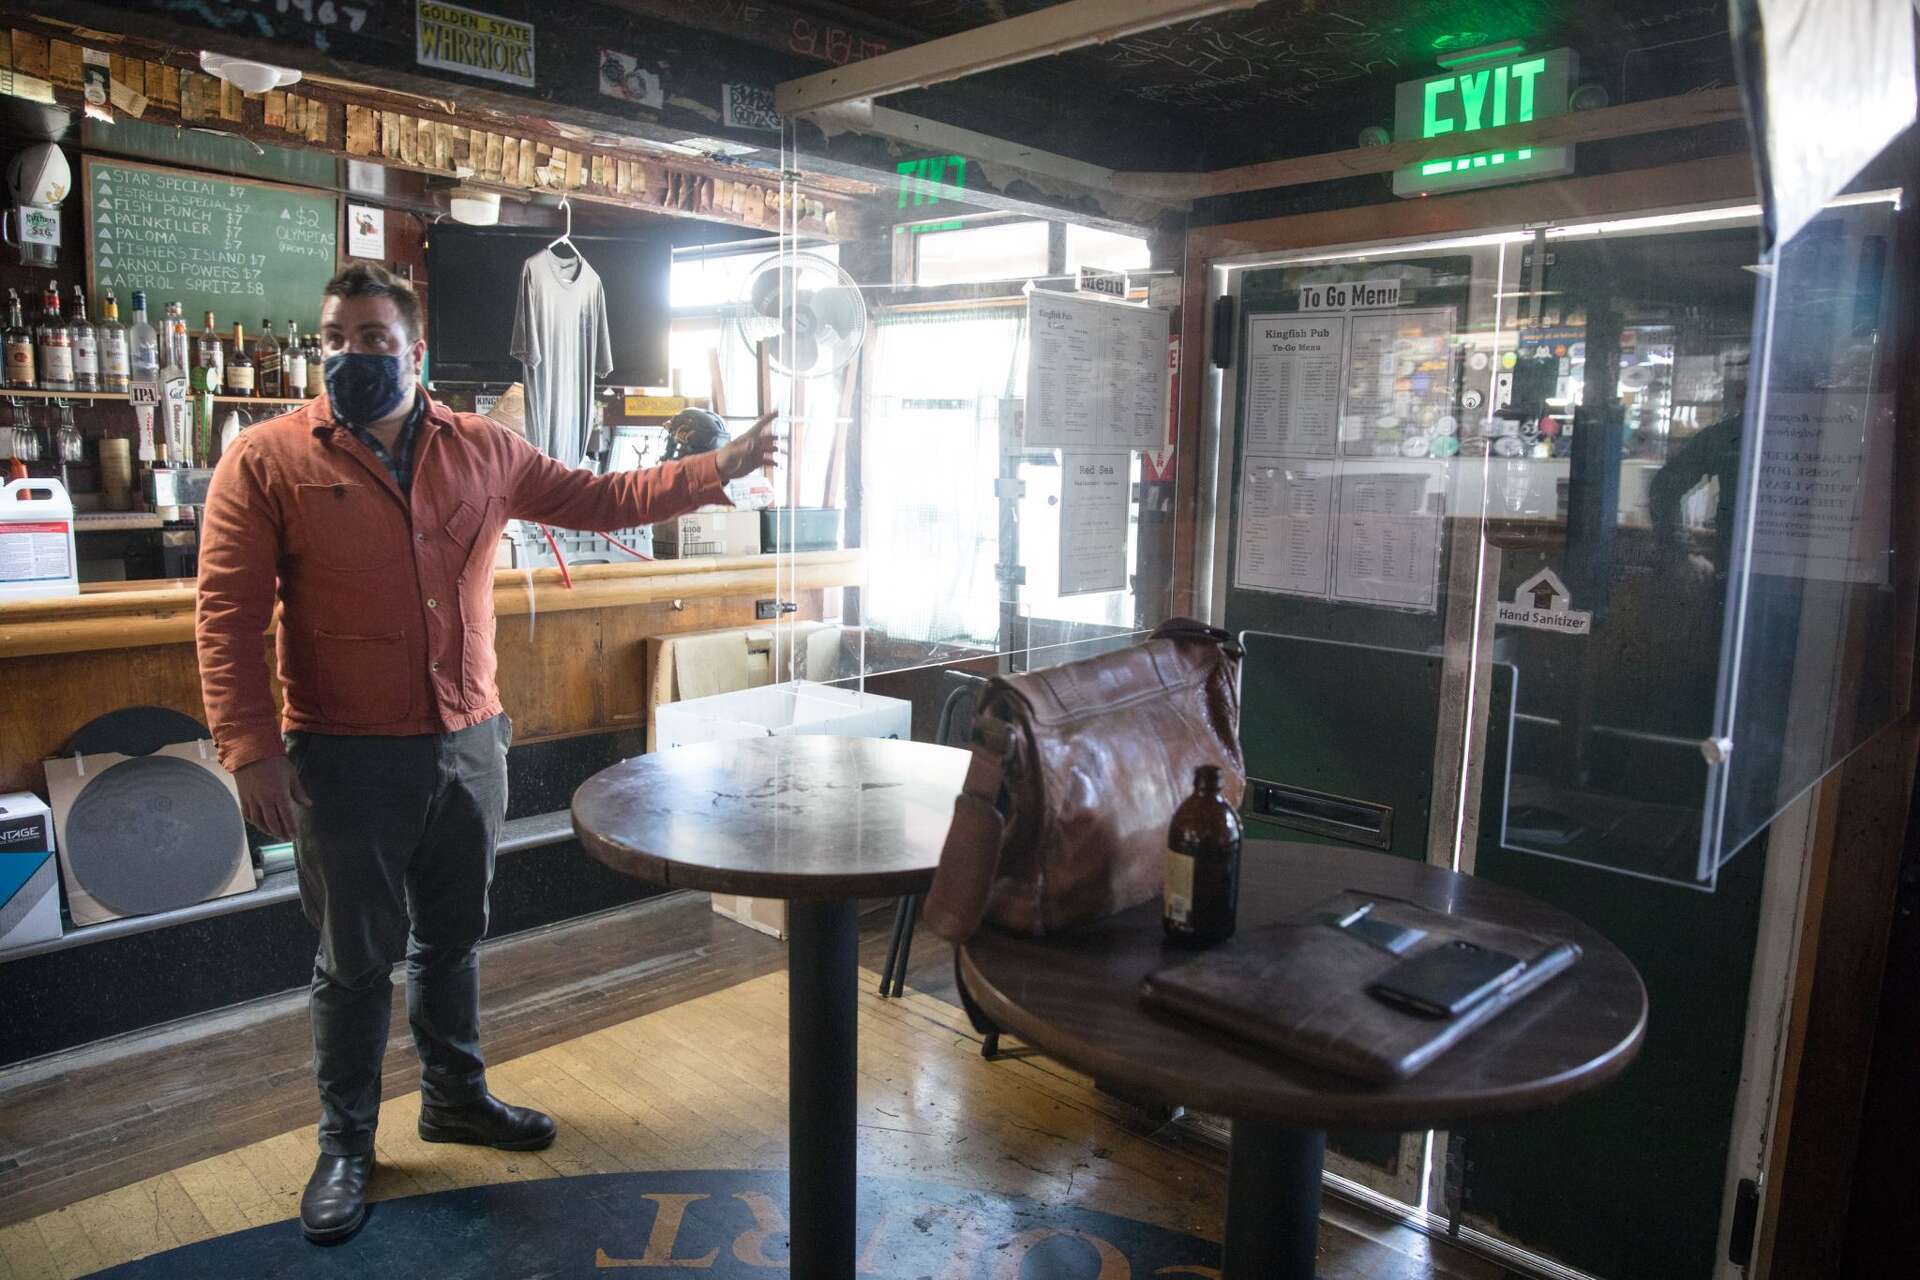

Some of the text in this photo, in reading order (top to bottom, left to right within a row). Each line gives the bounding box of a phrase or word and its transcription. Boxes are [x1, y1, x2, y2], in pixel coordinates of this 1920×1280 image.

[421, 4, 530, 39] GOLDEN STATE
[421, 20, 533, 78] WARRIORS
[1423, 58, 1545, 176] EXIT
[113, 169, 151, 186] STAR
[229, 185, 246, 198] $7
[115, 198, 243, 225] FISH PUNCH $7
[116, 186, 250, 214] ESTRELLA SPECIAL $7
[115, 212, 243, 239] PAINKILLER $7
[295, 207, 320, 229] $2
[116, 227, 243, 250] PALOMA $7
[117, 241, 267, 268] FISHERS ISLAND $7
[115, 257, 262, 281] ARNOLD POWERS $7
[114, 272, 265, 296] APEROL SPRITZ $8
[1081, 268, 1125, 295] Menu
[1303, 284, 1399, 308] To Go Menu
[1265, 328, 1330, 341] Kingfish Pub
[1272, 343, 1321, 352] To-Go Menu
[133, 388, 155, 401] IPA
[1079, 464, 1114, 475] Red Sea
[1499, 608, 1585, 628] Hand Sanitizer
